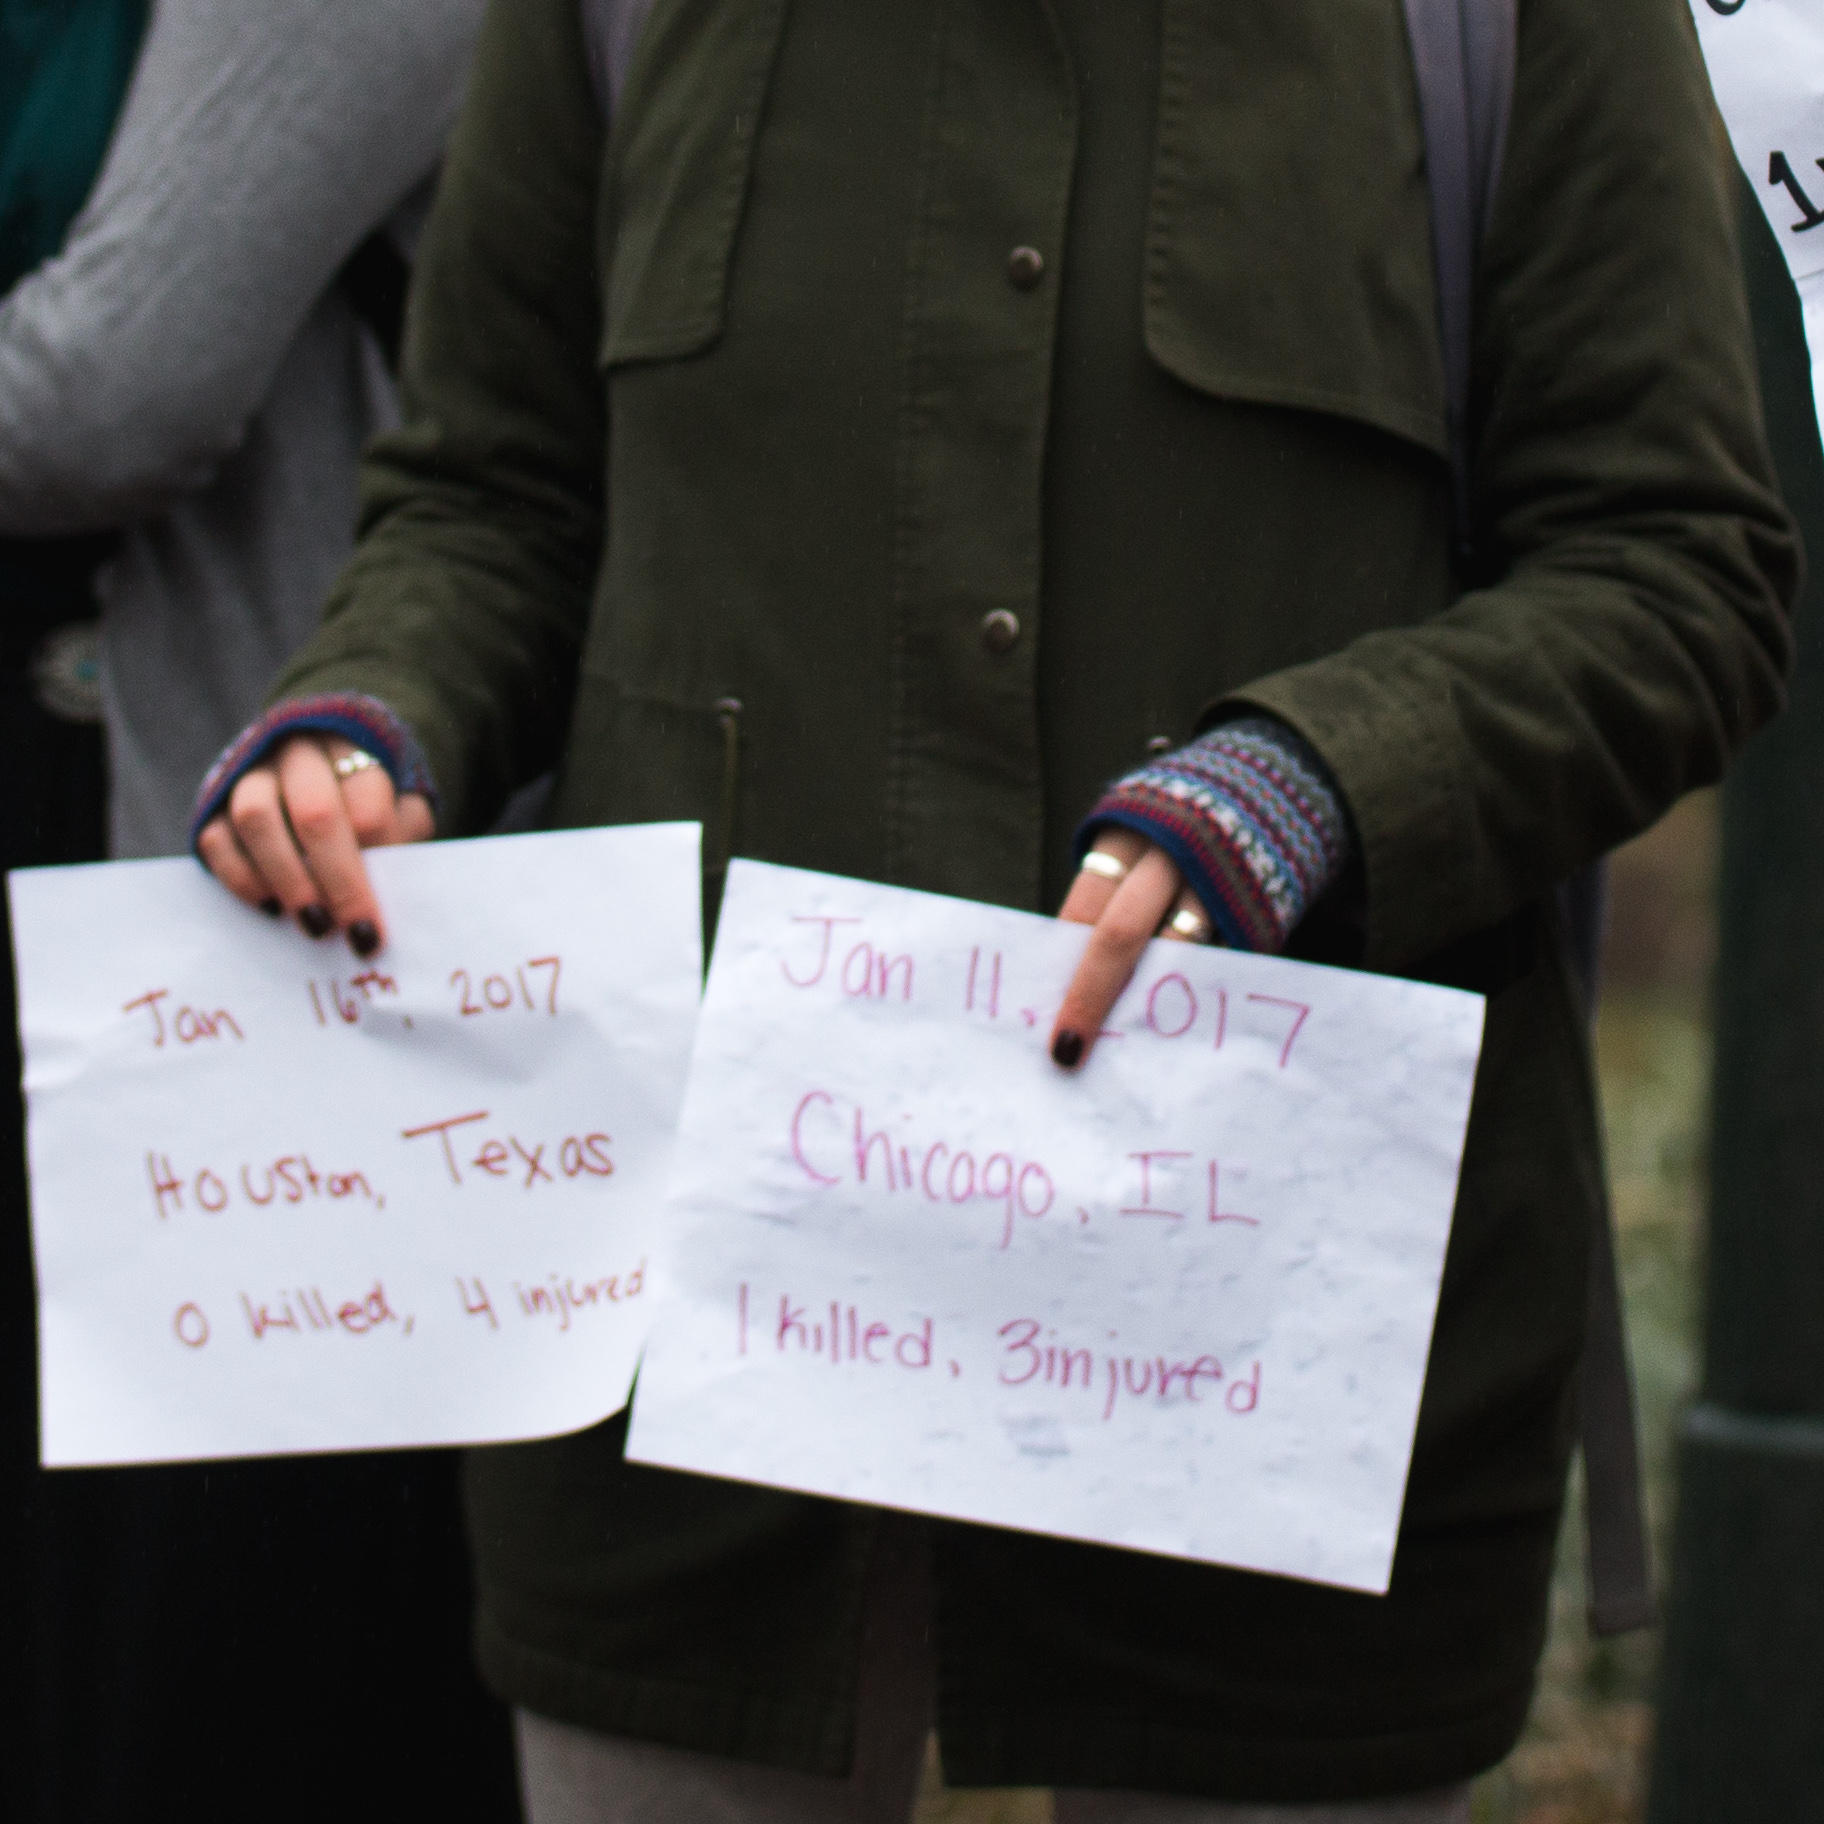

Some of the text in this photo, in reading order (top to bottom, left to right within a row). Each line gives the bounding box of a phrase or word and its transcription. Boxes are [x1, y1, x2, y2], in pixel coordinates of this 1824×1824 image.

[122, 987, 246, 1049] Jan
[450, 954, 564, 1019] 2017
[779, 915, 914, 1003] Jan
[1094, 972, 1313, 1068] 017
[401, 1109, 617, 1189] Texas
[1119, 1150, 1261, 1228] IL
[455, 1275, 500, 1331] 4
[515, 1256, 650, 1334] injured
